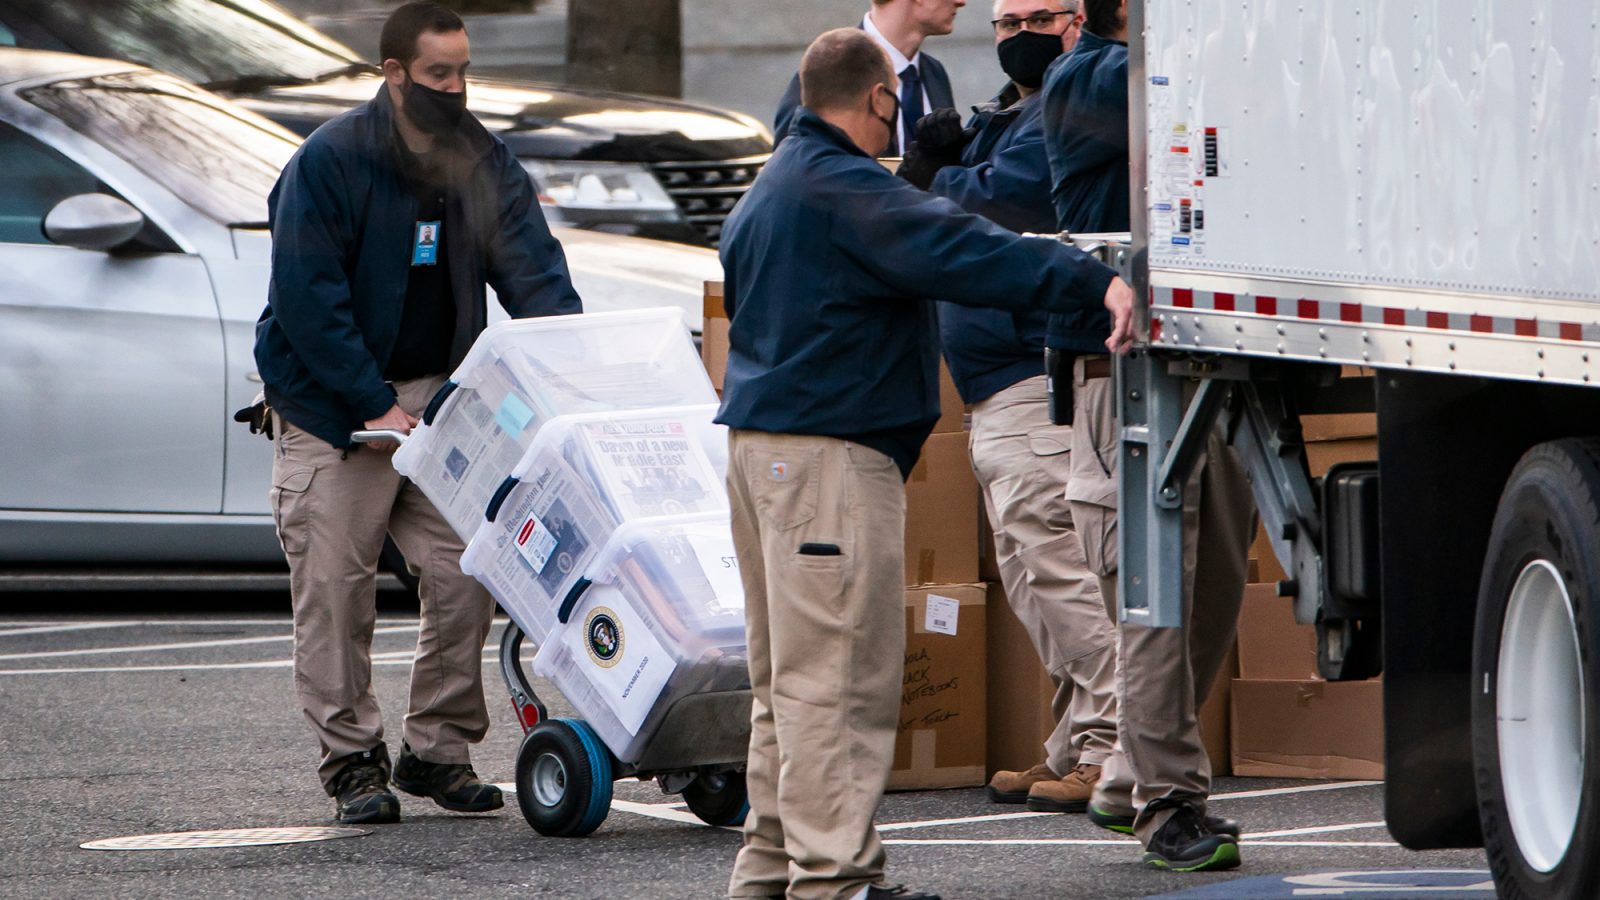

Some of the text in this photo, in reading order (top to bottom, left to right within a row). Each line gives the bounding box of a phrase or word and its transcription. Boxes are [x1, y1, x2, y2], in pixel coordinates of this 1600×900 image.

[636, 440, 650, 452] of
[651, 442, 661, 451] a
[662, 440, 689, 452] new
[503, 487, 540, 533] Washington
[721, 556, 737, 569] ST
[621, 655, 649, 699] NOVEMBER 2020
